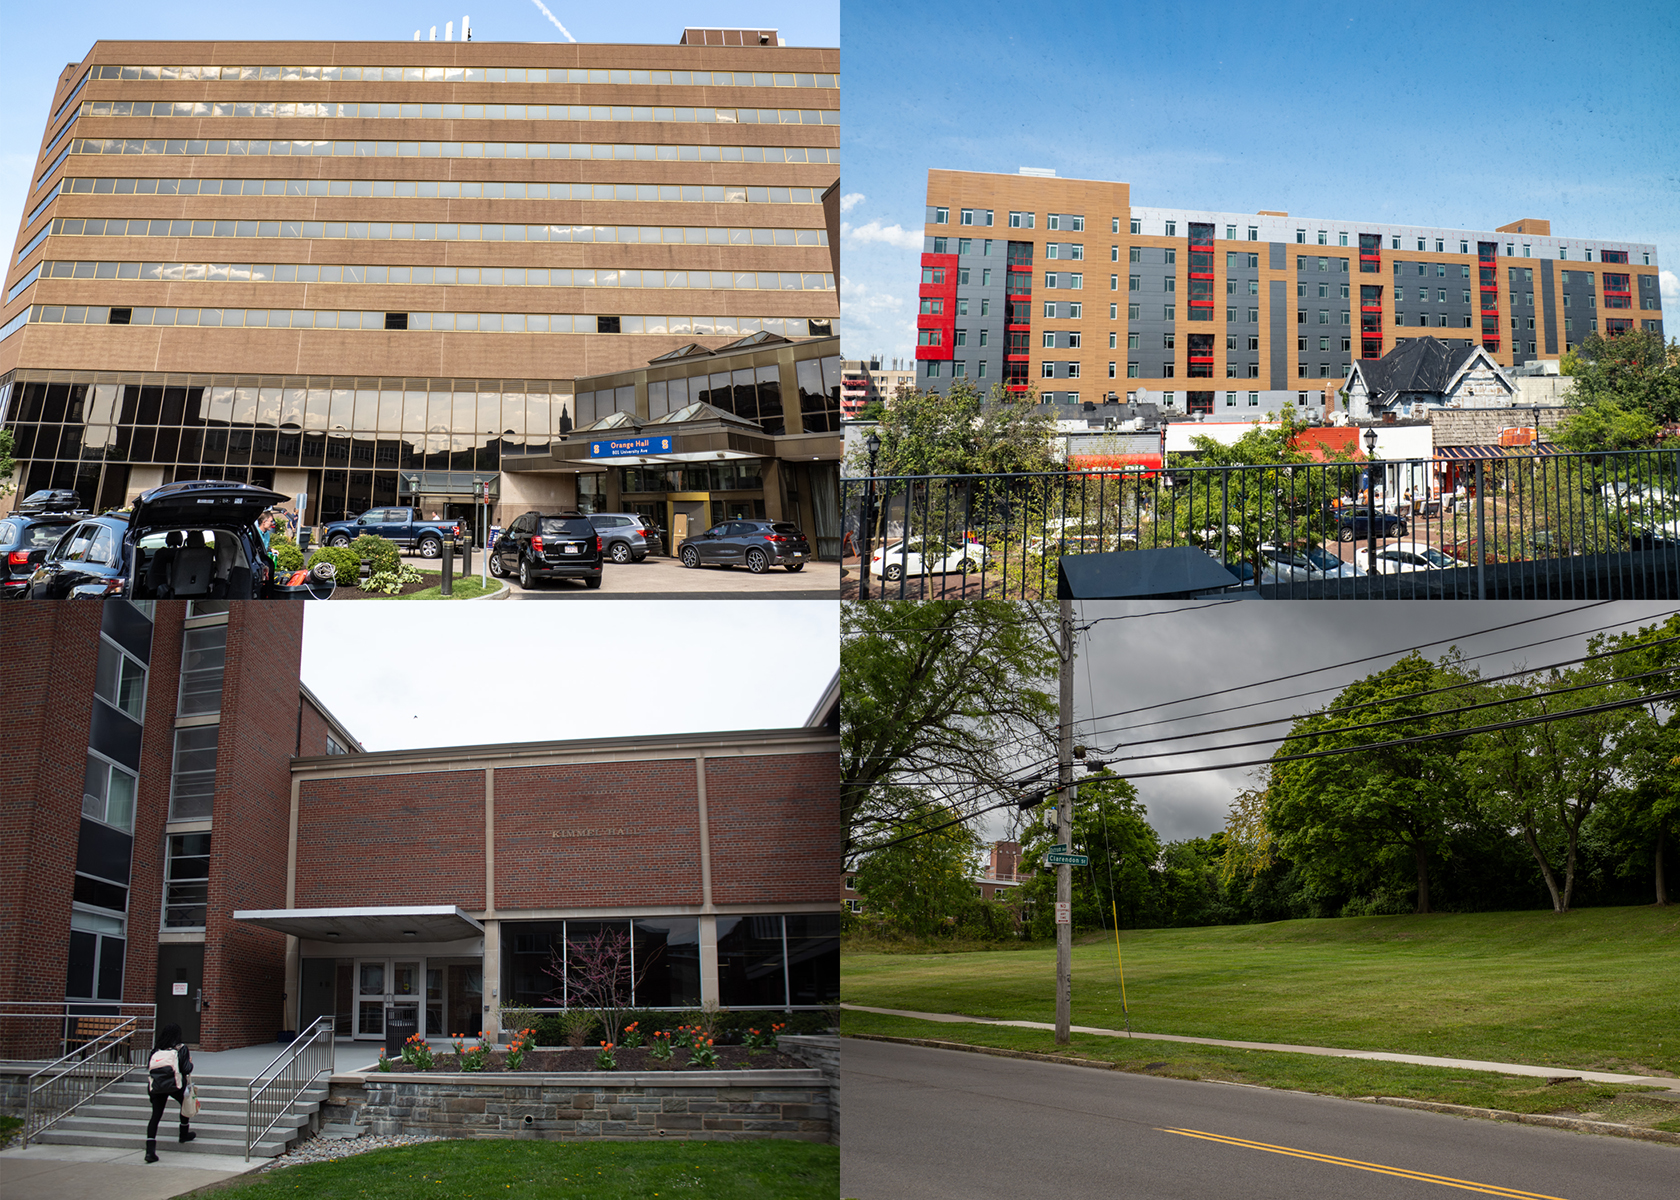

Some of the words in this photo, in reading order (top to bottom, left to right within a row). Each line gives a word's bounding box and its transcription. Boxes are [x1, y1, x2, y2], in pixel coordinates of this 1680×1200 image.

[552, 829, 602, 838] KIMMEL
[607, 827, 640, 836] HALL
[1049, 855, 1080, 863] Clarendon
